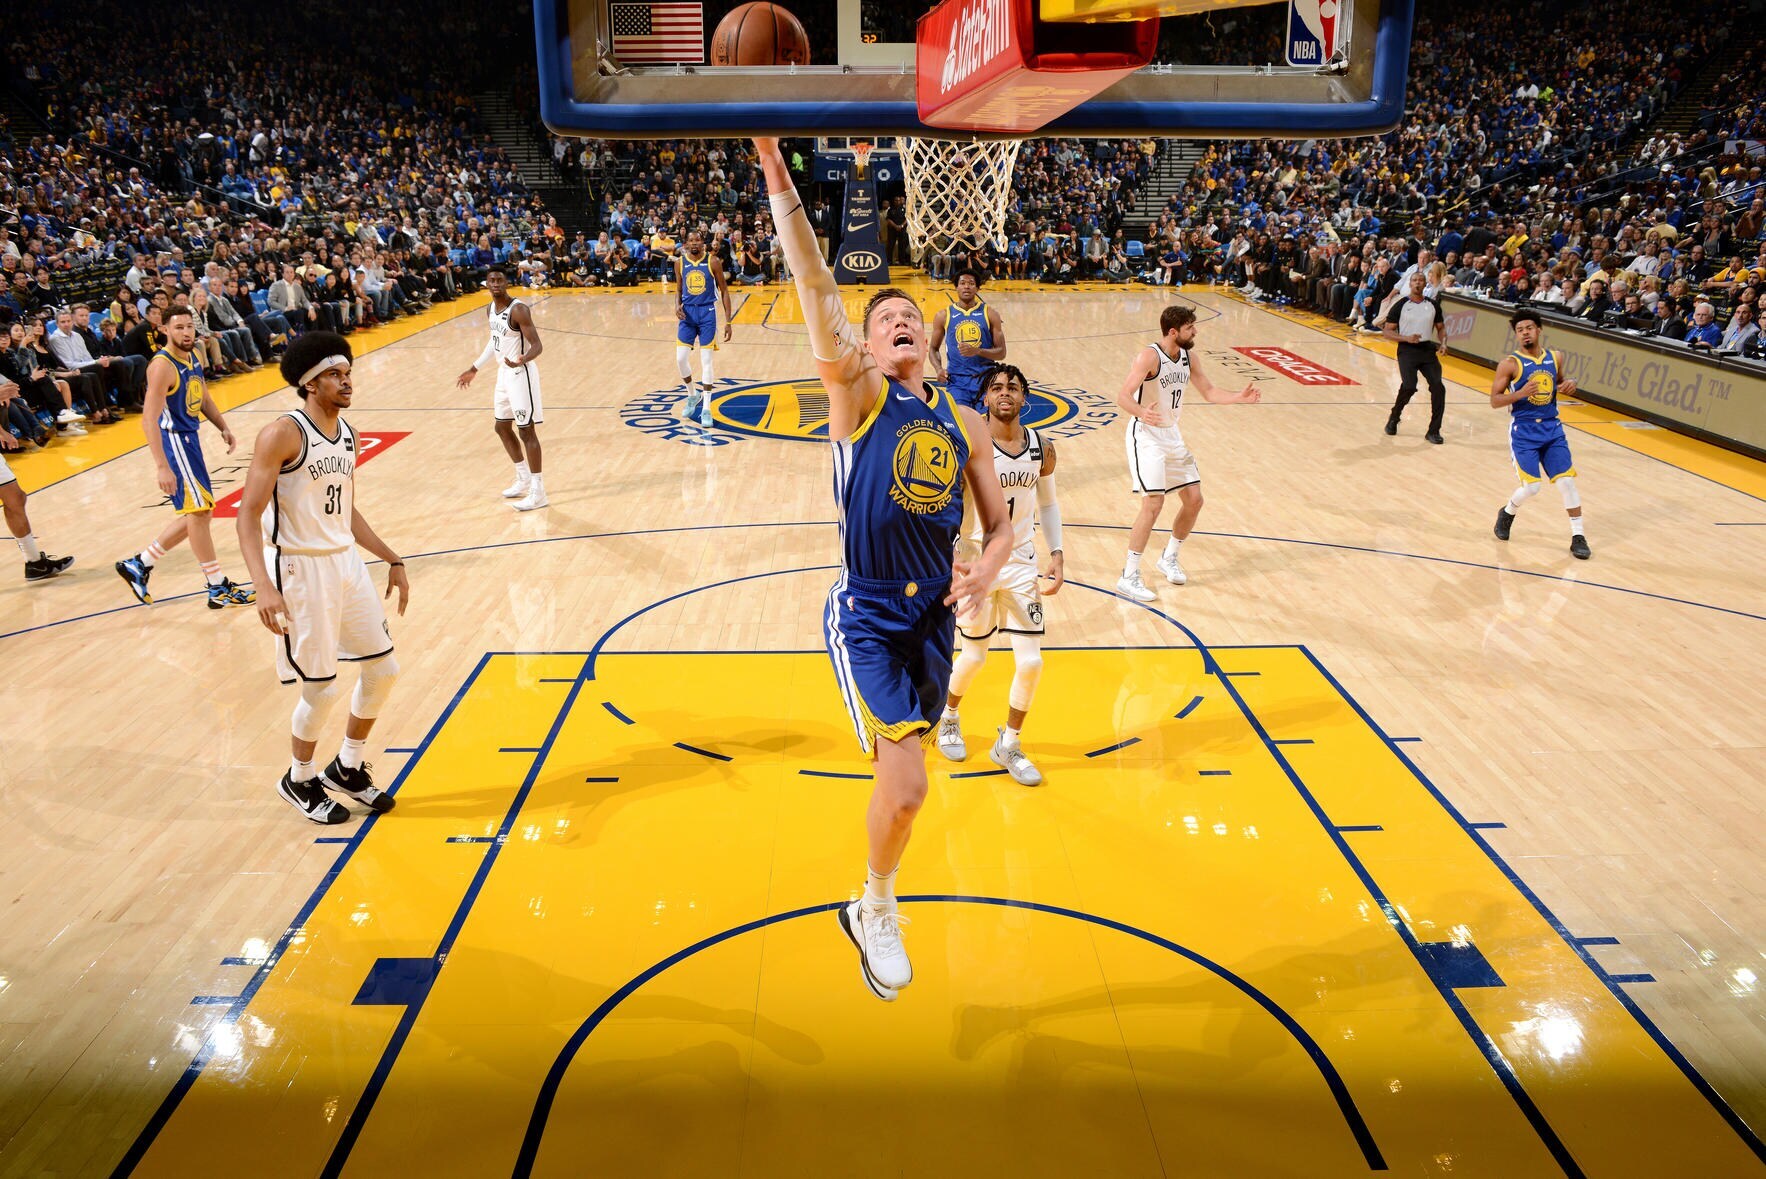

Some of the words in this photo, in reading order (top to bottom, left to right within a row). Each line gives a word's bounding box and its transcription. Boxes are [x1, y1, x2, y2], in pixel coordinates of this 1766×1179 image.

[1293, 40, 1317, 60] NBA
[848, 255, 875, 268] KIA
[1250, 349, 1341, 383] ORACLE
[1597, 351, 1632, 391] It's
[1171, 389, 1182, 410] 12
[896, 419, 934, 438] GOLDEN
[1047, 410, 1119, 441] STAT
[930, 446, 949, 469] 21
[999, 471, 1040, 490] OOKLY
[324, 483, 342, 515] 31
[888, 484, 952, 515] WARRIORS
[1007, 497, 1015, 521] 1
